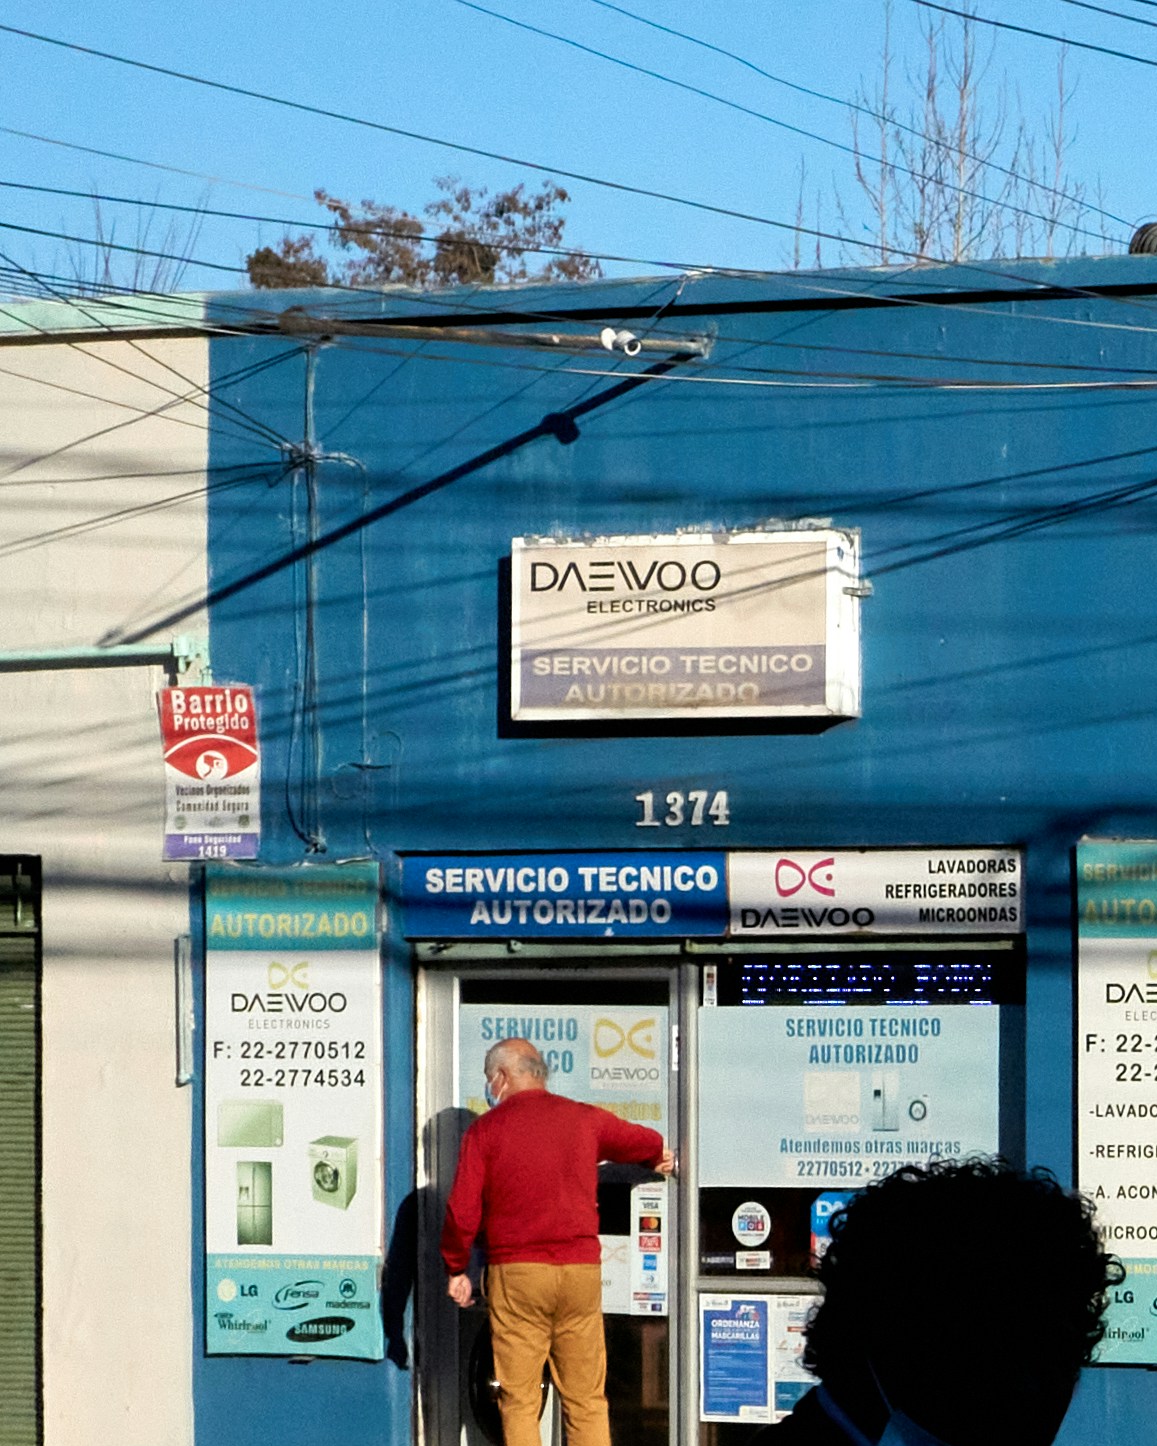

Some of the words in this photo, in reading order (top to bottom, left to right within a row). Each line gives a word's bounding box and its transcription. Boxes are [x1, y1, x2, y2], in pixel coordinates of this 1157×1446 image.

[530, 560, 721, 592] DAEWOO
[587, 599, 716, 614] ELECTRONICS
[532, 655, 671, 676] SERVICIO
[680, 653, 813, 675] TECNICO
[564, 682, 761, 703] AUTORIZADO
[171, 689, 248, 715] Barrio
[173, 714, 249, 733] Protegido
[635, 791, 730, 827] 1374
[199, 846, 227, 858] 1419
[928, 858, 1018, 874] LAVADORAS
[425, 868, 570, 893] SERVICIO
[578, 865, 719, 892] TECNICO
[885, 882, 1018, 899] REFRIGERADORES
[470, 898, 672, 925] AUTORIZADO
[741, 907, 875, 928] DAEWOO
[919, 907, 1018, 923] MICROONDAS
[210, 911, 369, 938] AUTORIZADO
[231, 992, 347, 1013] DAEWOO
[248, 1019, 330, 1029] ELECTRONICS
[481, 1017, 578, 1041] SERVICIO
[786, 1018, 863, 1037] SERVICIO
[870, 1018, 941, 1037] TECNICO
[213, 1041, 232, 1059] F:
[240, 1041, 366, 1059] 22-2770512
[1086, 1034, 1105, 1053] F:
[809, 1044, 919, 1064] AUTORIZADO
[240, 1069, 366, 1087] 22-2774534
[591, 1067, 659, 1080] DAEWOO
[780, 1138, 861, 1154] Atendemos
[865, 1139, 902, 1154] otras
[907, 1139, 961, 1155] marcas
[797, 1160, 863, 1177] 22770512
[241, 1285, 258, 1297] LG
[1115, 1291, 1134, 1303] LG
[294, 1323, 348, 1335] SAMSUNG
[711, 1319, 759, 1328] ORDENANZA
[1103, 1327, 1145, 1341] irlpool
